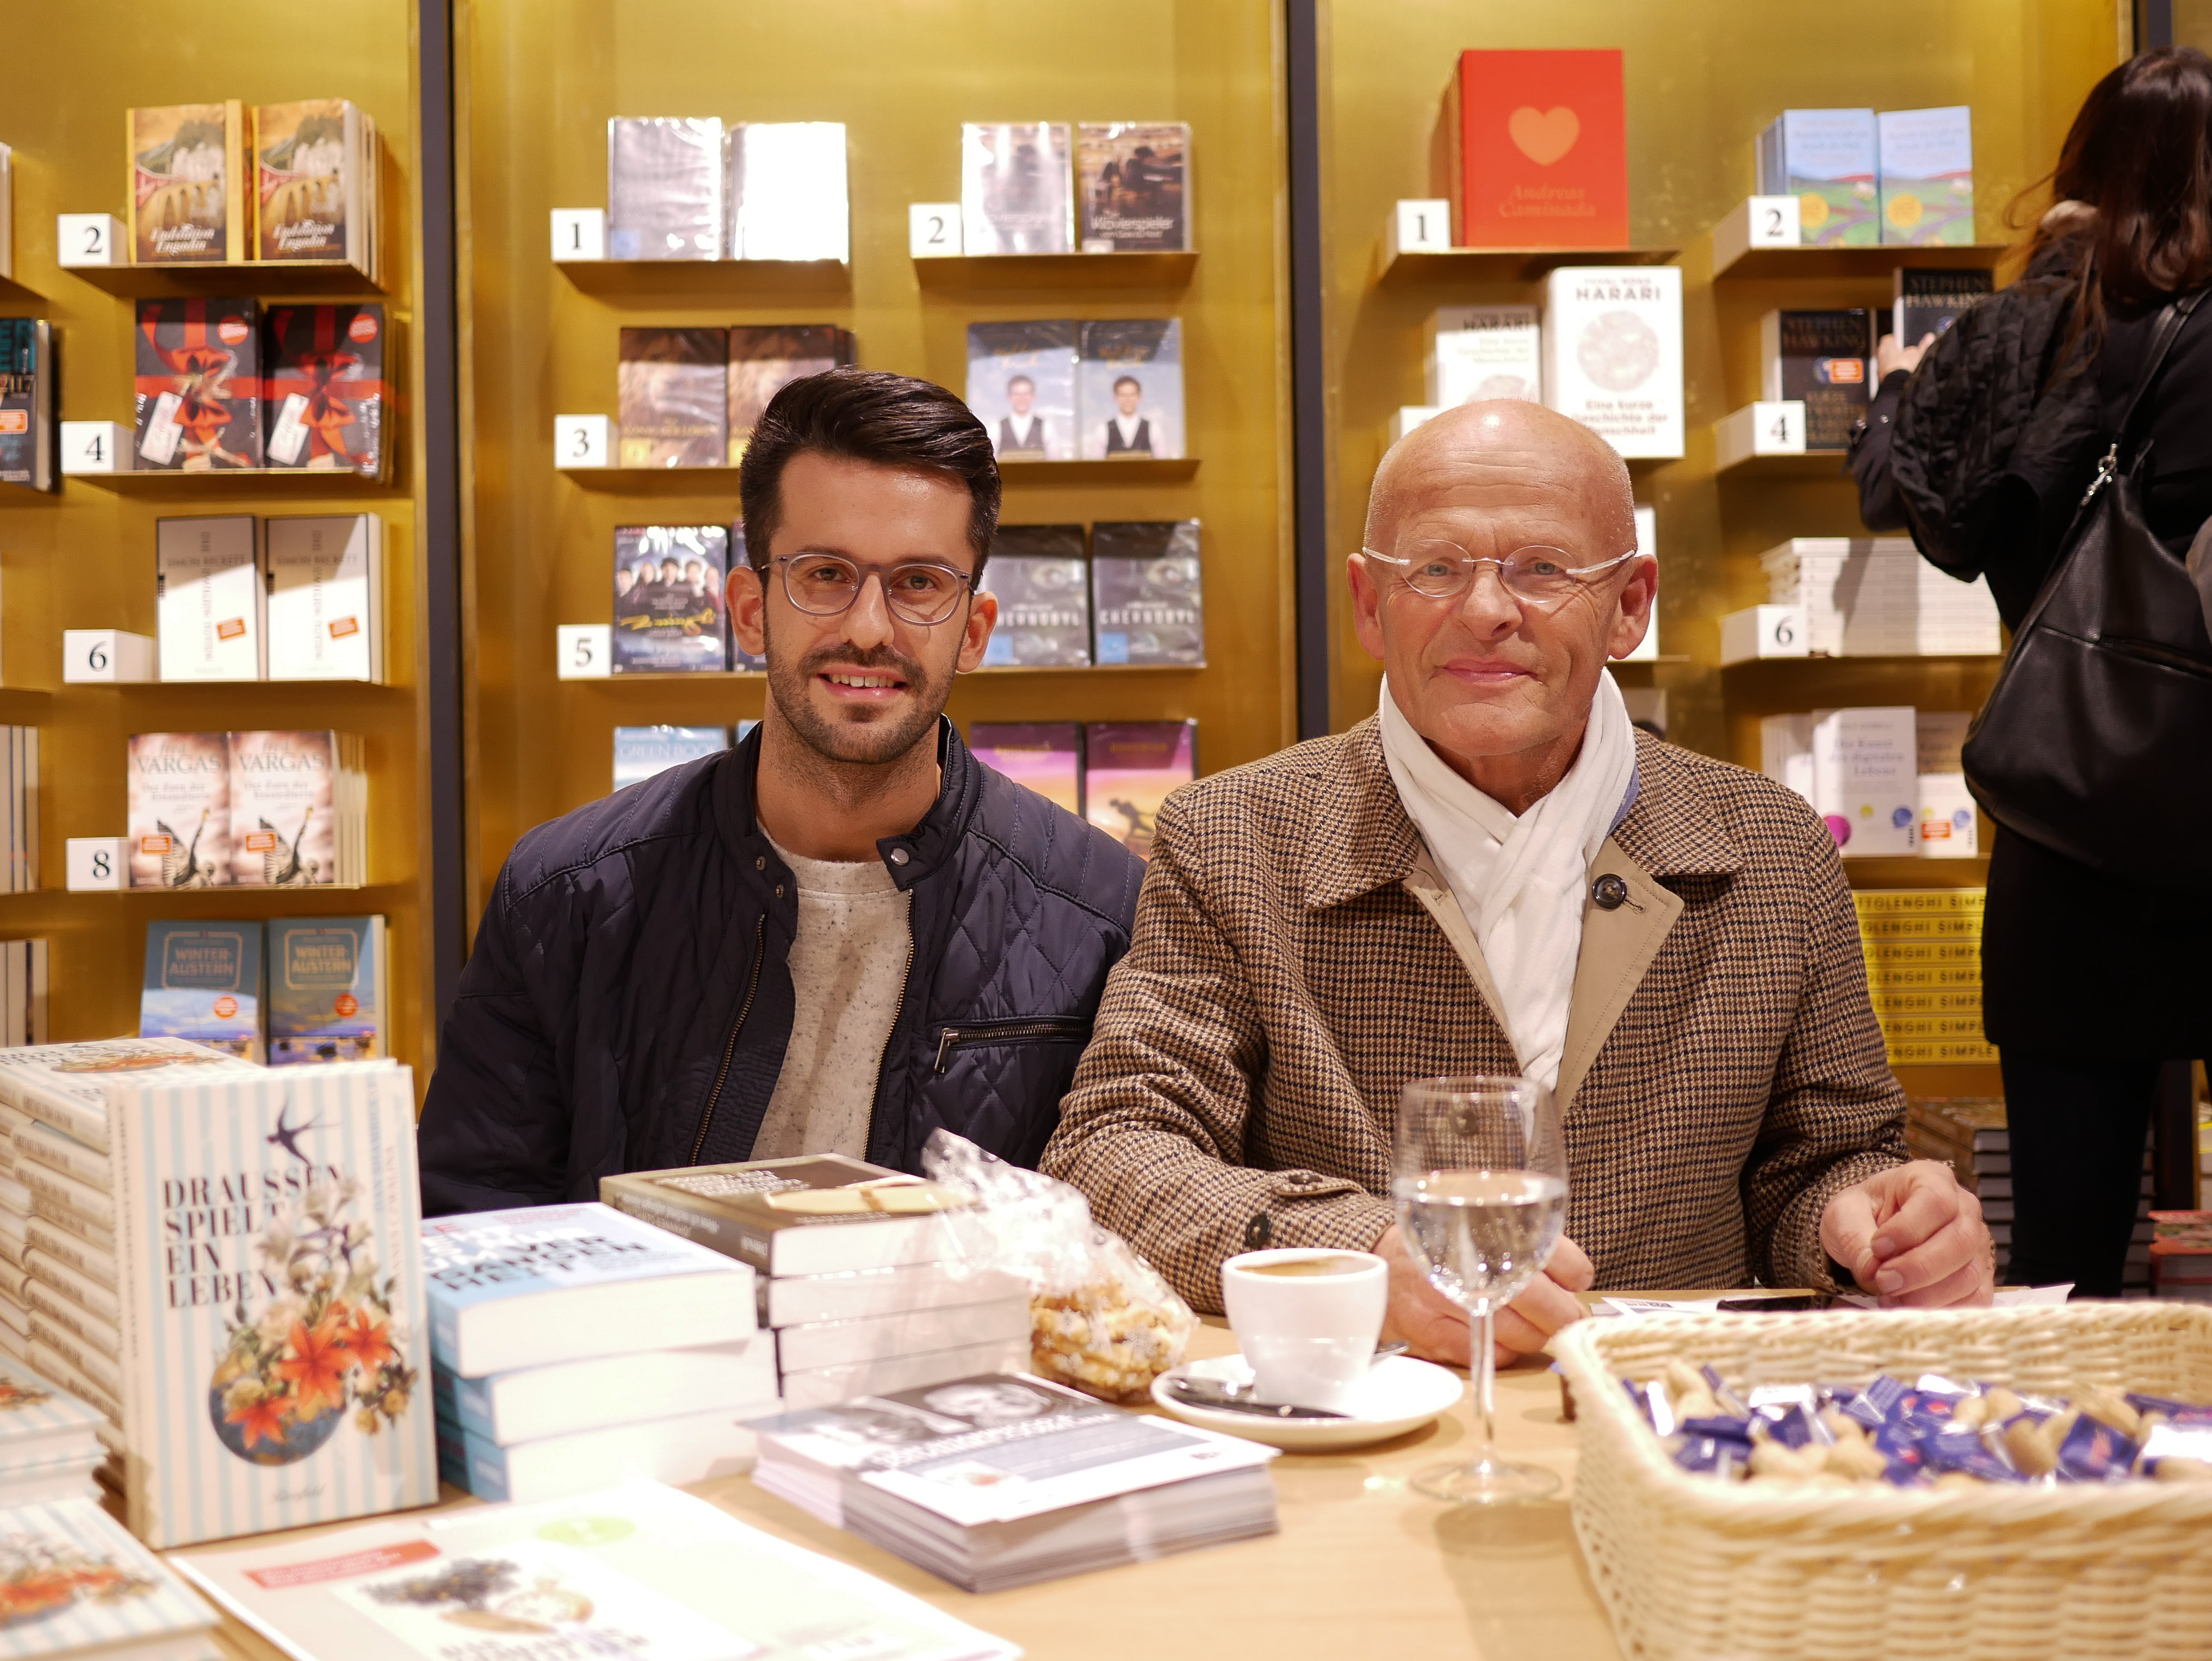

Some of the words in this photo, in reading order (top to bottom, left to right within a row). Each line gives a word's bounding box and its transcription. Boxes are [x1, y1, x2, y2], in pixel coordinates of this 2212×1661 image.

[572, 222, 583, 250] 1
[928, 216, 946, 244] 2
[1416, 214, 1428, 242] 1
[1765, 208, 1785, 238] 2
[84, 226, 103, 254] 2
[1576, 286, 1660, 301] HARARI
[572, 429, 590, 457] 3
[1770, 414, 1789, 444] 4
[85, 434, 104, 462] 4
[997, 611, 1080, 627] HERNOBYL
[1099, 609, 1195, 625] CHERNOBYL
[1774, 616, 1794, 647] 6
[89, 641, 109, 672] 6
[574, 637, 594, 668] 5
[137, 753, 222, 775] VARGAS
[239, 751, 325, 773] VARGAS
[619, 743, 671, 758] GREEN
[92, 850, 110, 880] 8
[1858, 896, 1942, 910] TTOLENGHI
[1949, 895, 1985, 909] SIMP
[1863, 921, 1930, 934] OLENGHI
[1864, 946, 1932, 960] OLENGHI
[1940, 946, 1975, 959] SIMP
[1940, 970, 1975, 984] SIMP
[1885, 1020, 1932, 1034] ENGHI
[1940, 1044, 1994, 1058] SIMPLE
[163, 1163, 342, 1210] DRAUSSEN
[164, 1200, 286, 1243] SPIELT
[164, 1241, 221, 1275] EIN
[168, 1270, 277, 1309] LEBEN
